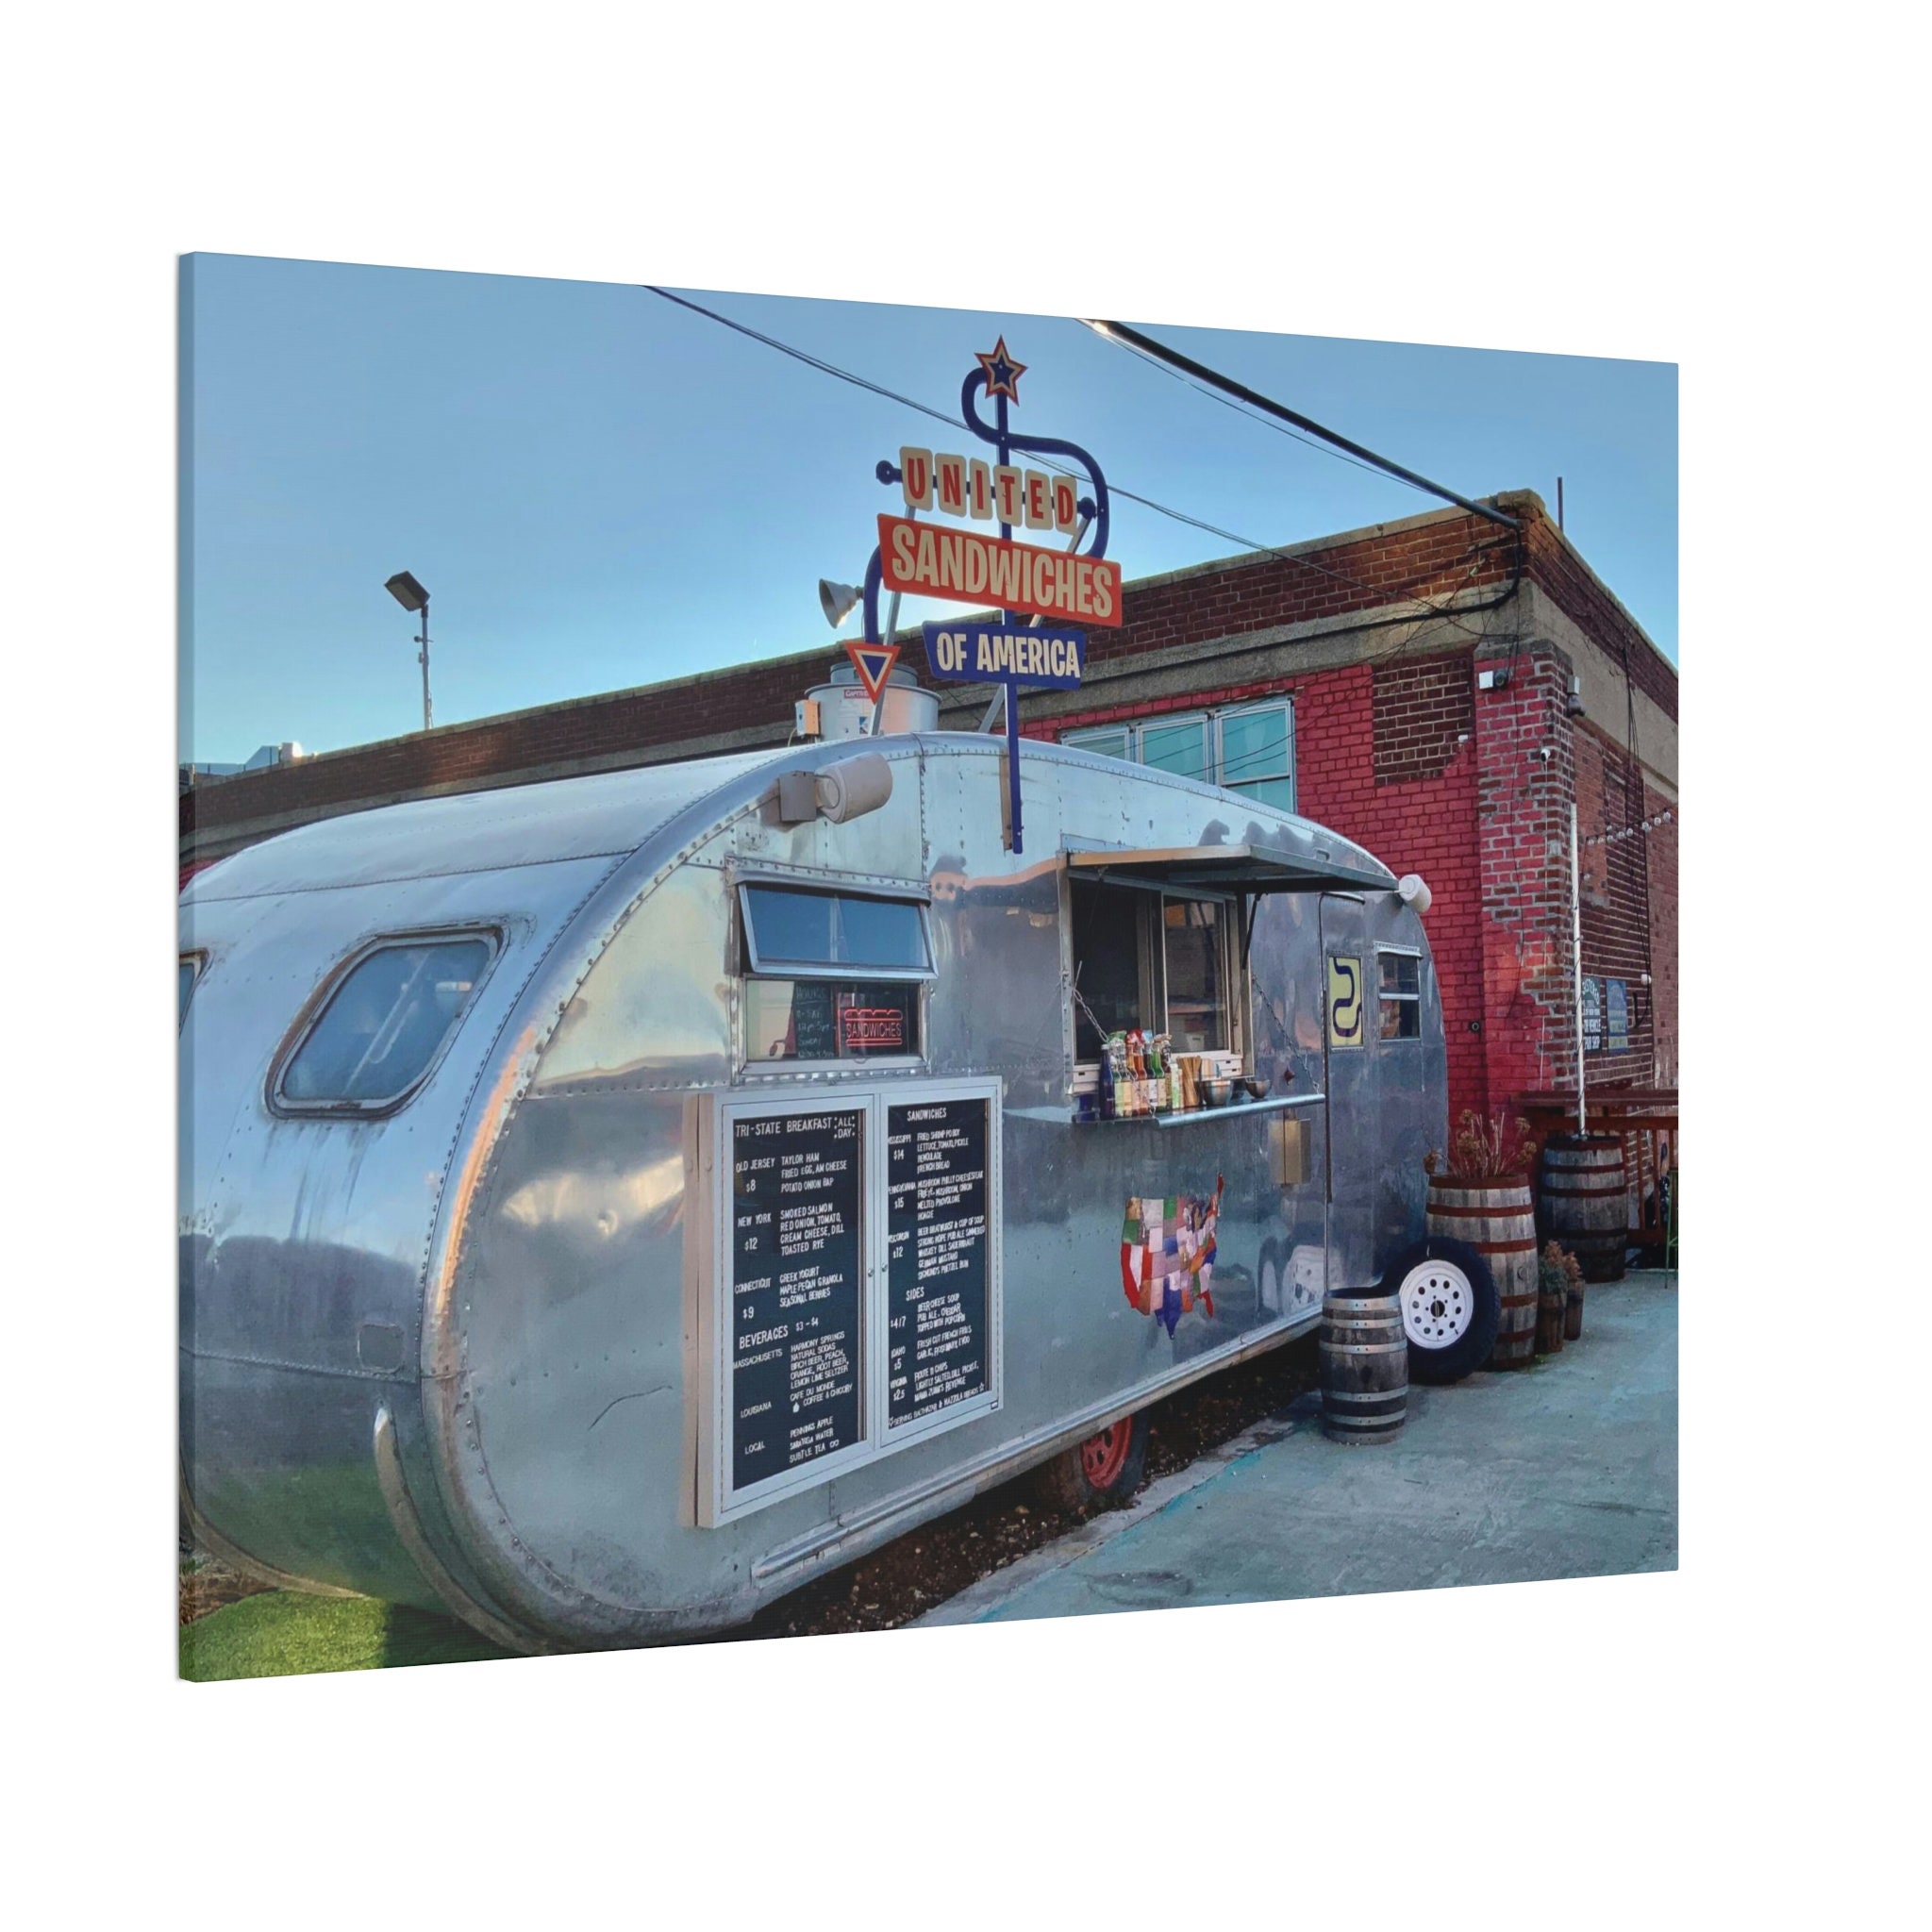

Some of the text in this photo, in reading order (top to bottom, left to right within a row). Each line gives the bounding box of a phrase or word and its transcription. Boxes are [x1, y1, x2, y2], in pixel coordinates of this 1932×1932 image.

[907, 458, 1074, 525] UNITED
[891, 525, 1112, 618] SANDWICHES
[937, 632, 1080, 678] OF AMERICA
[846, 1023, 901, 1037] SANDWICHES
[907, 1108, 947, 1122] SANDWICHES
[735, 1122, 781, 1137] TRI-STATE
[787, 1118, 833, 1133] BREAKFAST
[917, 1132, 929, 1141] FRIED
[781, 1153, 819, 1166] TAYLOR HAM
[893, 1149, 904, 1160] $14
[736, 1158, 775, 1173] OLD JERSEY
[781, 1169, 798, 1179] FRIED
[825, 1160, 847, 1170] CHEESE
[917, 1160, 950, 1174] FRENCH BREAD
[746, 1179, 756, 1192] $8
[781, 1183, 802, 1193] POTATO
[804, 1180, 822, 1190] ONION
[918, 1178, 941, 1189] MUSHROOM
[917, 1194, 960, 1210] MELTED PROVOLONE
[780, 1203, 833, 1220] SMOKED SALMON
[738, 1213, 772, 1227] NEW YORK
[780, 1221, 794, 1232] RED
[918, 1226, 928, 1237] BEER
[974, 1215, 985, 1224] SOUP
[780, 1232, 802, 1244] CREAM
[831, 1224, 844, 1234] DILL
[957, 1228, 965, 1239] ALE
[744, 1237, 758, 1251] $12
[781, 1241, 824, 1257] TOASTED RYE
[918, 1246, 937, 1257] WHISKEY
[918, 1257, 937, 1269] GERMAN
[779, 1266, 820, 1284] GREEK YOGURT
[735, 1277, 771, 1294] CONNECTICUT
[780, 1274, 843, 1295] MAPLE PECAN GRANOLA
[779, 1288, 831, 1307] SEASONAL BERRIES
[906, 1287, 924, 1301] SIDES
[918, 1292, 959, 1312] BEER CHEESE SOUP
[742, 1307, 754, 1319] $9
[917, 1313, 926, 1323] PUB
[917, 1322, 933, 1333] TOPPED
[934, 1318, 943, 1327] WITH
[740, 1325, 789, 1349] BEVERAGES
[791, 1331, 845, 1353] HARMONY SPRINGS
[917, 1325, 972, 1349] FRESH CUT FRENCH FRIES
[791, 1342, 837, 1361] NATURAL SODAS
[891, 1346, 906, 1358] IDAHO
[791, 1360, 807, 1371] BIRCH
[817, 1362, 831, 1372] ROOT
[934, 1361, 948, 1373] CHIPS
[791, 1365, 848, 1390] LEMON LIME SELTZER
[945, 1376, 966, 1392] REVENGE
[790, 1380, 836, 1402] CAFE DU MONDE
[803, 1393, 824, 1406] COFFEE
[741, 1401, 772, 1419] LOUISIANA
[817, 1416, 833, 1429] APPLE
[816, 1427, 834, 1441] WATER
[744, 1441, 766, 1455] LOCAL
[789, 1442, 825, 1463] SUBTLE TEA
